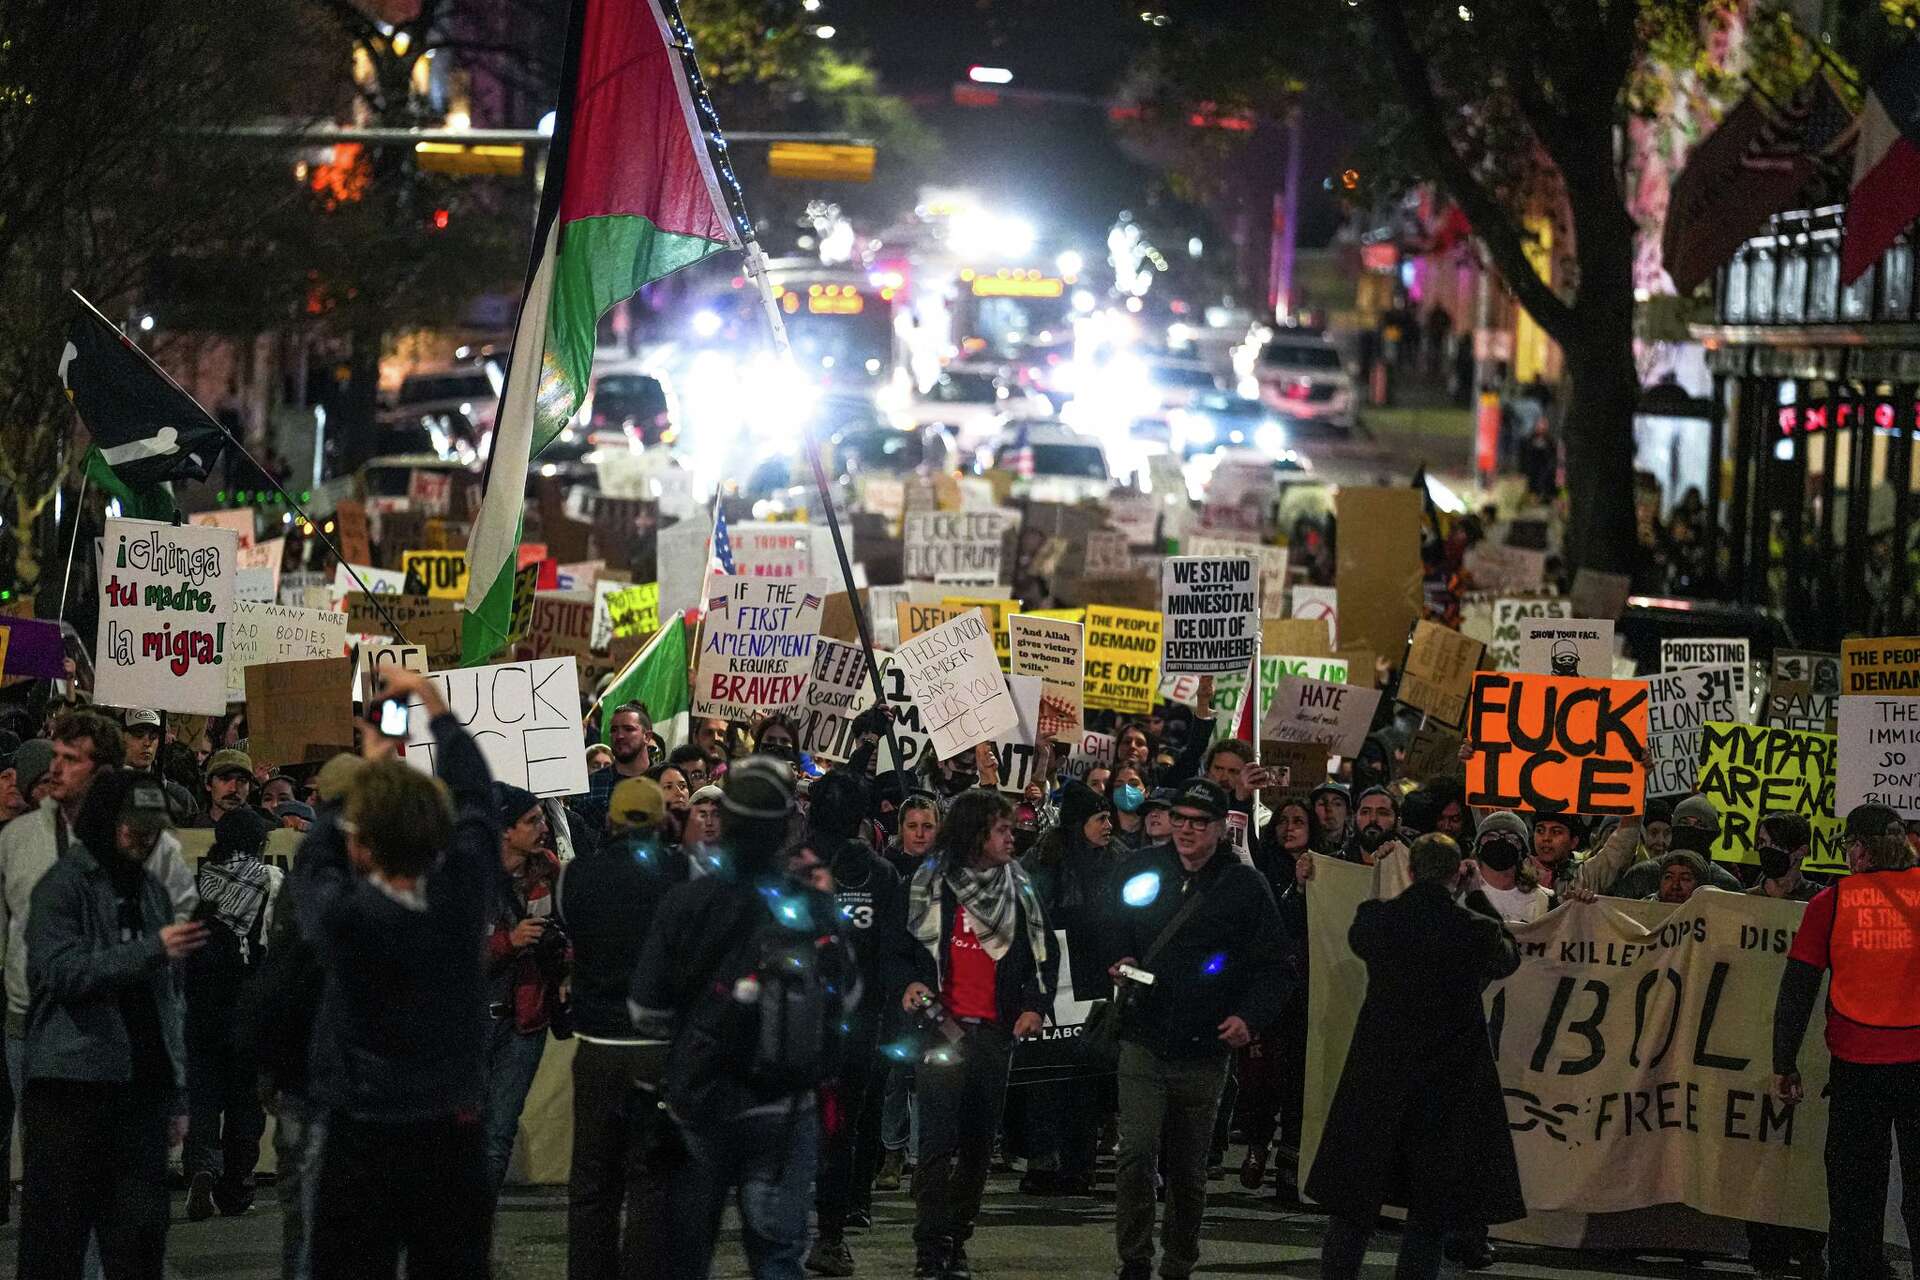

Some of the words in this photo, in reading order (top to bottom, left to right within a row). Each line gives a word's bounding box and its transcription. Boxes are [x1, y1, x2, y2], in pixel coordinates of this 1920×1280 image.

[1173, 561, 1199, 584] WE
[1201, 560, 1250, 583] STAND
[105, 575, 138, 607] tu
[144, 582, 217, 613] madre,
[734, 582, 750, 601] IF
[767, 583, 798, 604] THE
[1190, 583, 1234, 593] WITH
[1167, 592, 1254, 616] MINNESOTA!
[265, 606, 305, 622] MANY
[318, 611, 346, 626] MORE
[532, 599, 594, 639] USTICE
[737, 605, 793, 632] FIRST
[1091, 614, 1113, 628] THE
[1116, 617, 1161, 634] PEOPLE
[1174, 618, 1198, 639] ICE
[1199, 617, 1228, 638] OUT
[1229, 616, 1247, 637] OF
[275, 625, 327, 644] BODIES
[704, 631, 816, 658] AMENDMENT
[895, 633, 948, 670] THIS
[944, 613, 990, 648] UNION
[1044, 630, 1071, 642] Allah
[1088, 631, 1157, 654] DEMAND
[1529, 629, 1556, 640] SHOW
[1556, 630, 1578, 639] YOUR
[108, 620, 136, 667] la
[142, 622, 227, 677] migra!
[279, 643, 293, 655] IT
[305, 645, 333, 659] TAKE
[1016, 638, 1042, 649] gives
[1043, 642, 1078, 656] victory
[1018, 650, 1029, 658] to
[1031, 652, 1060, 664] whom
[1062, 656, 1075, 666] He
[1663, 643, 1745, 663] PROTESTING
[1848, 650, 1879, 667] THE
[1882, 647, 1920, 665] PEOP
[728, 657, 790, 674] REQUIRES
[909, 647, 975, 688] MEMBER
[1084, 660, 1113, 680] ICE
[1117, 663, 1153, 685] OUT
[710, 673, 810, 706] BRAVERY
[807, 683, 865, 712] Reasons
[1100, 682, 1149, 699] AUSTIN!
[1300, 684, 1348, 711] HATE
[1649, 675, 1687, 703] HAS
[1696, 669, 1732, 701] 34
[696, 700, 715, 714] WE
[922, 690, 970, 730] FUCK
[964, 673, 999, 704] YOU
[1773, 692, 1839, 720] SAME
[1874, 701, 1918, 723] THE
[944, 704, 994, 751] ICE
[1470, 674, 1649, 763] FUCK
[1648, 700, 1735, 733] ELONIES
[1878, 751, 1907, 768] SO
[1467, 742, 1636, 815] ICE
[1858, 908, 1873, 928] IS
[1852, 928, 1914, 950] FUTURE
[1042, 1026, 1083, 1040] LABO
[1595, 1081, 1699, 1142] FREE
[1725, 1090, 1795, 1146] EM
